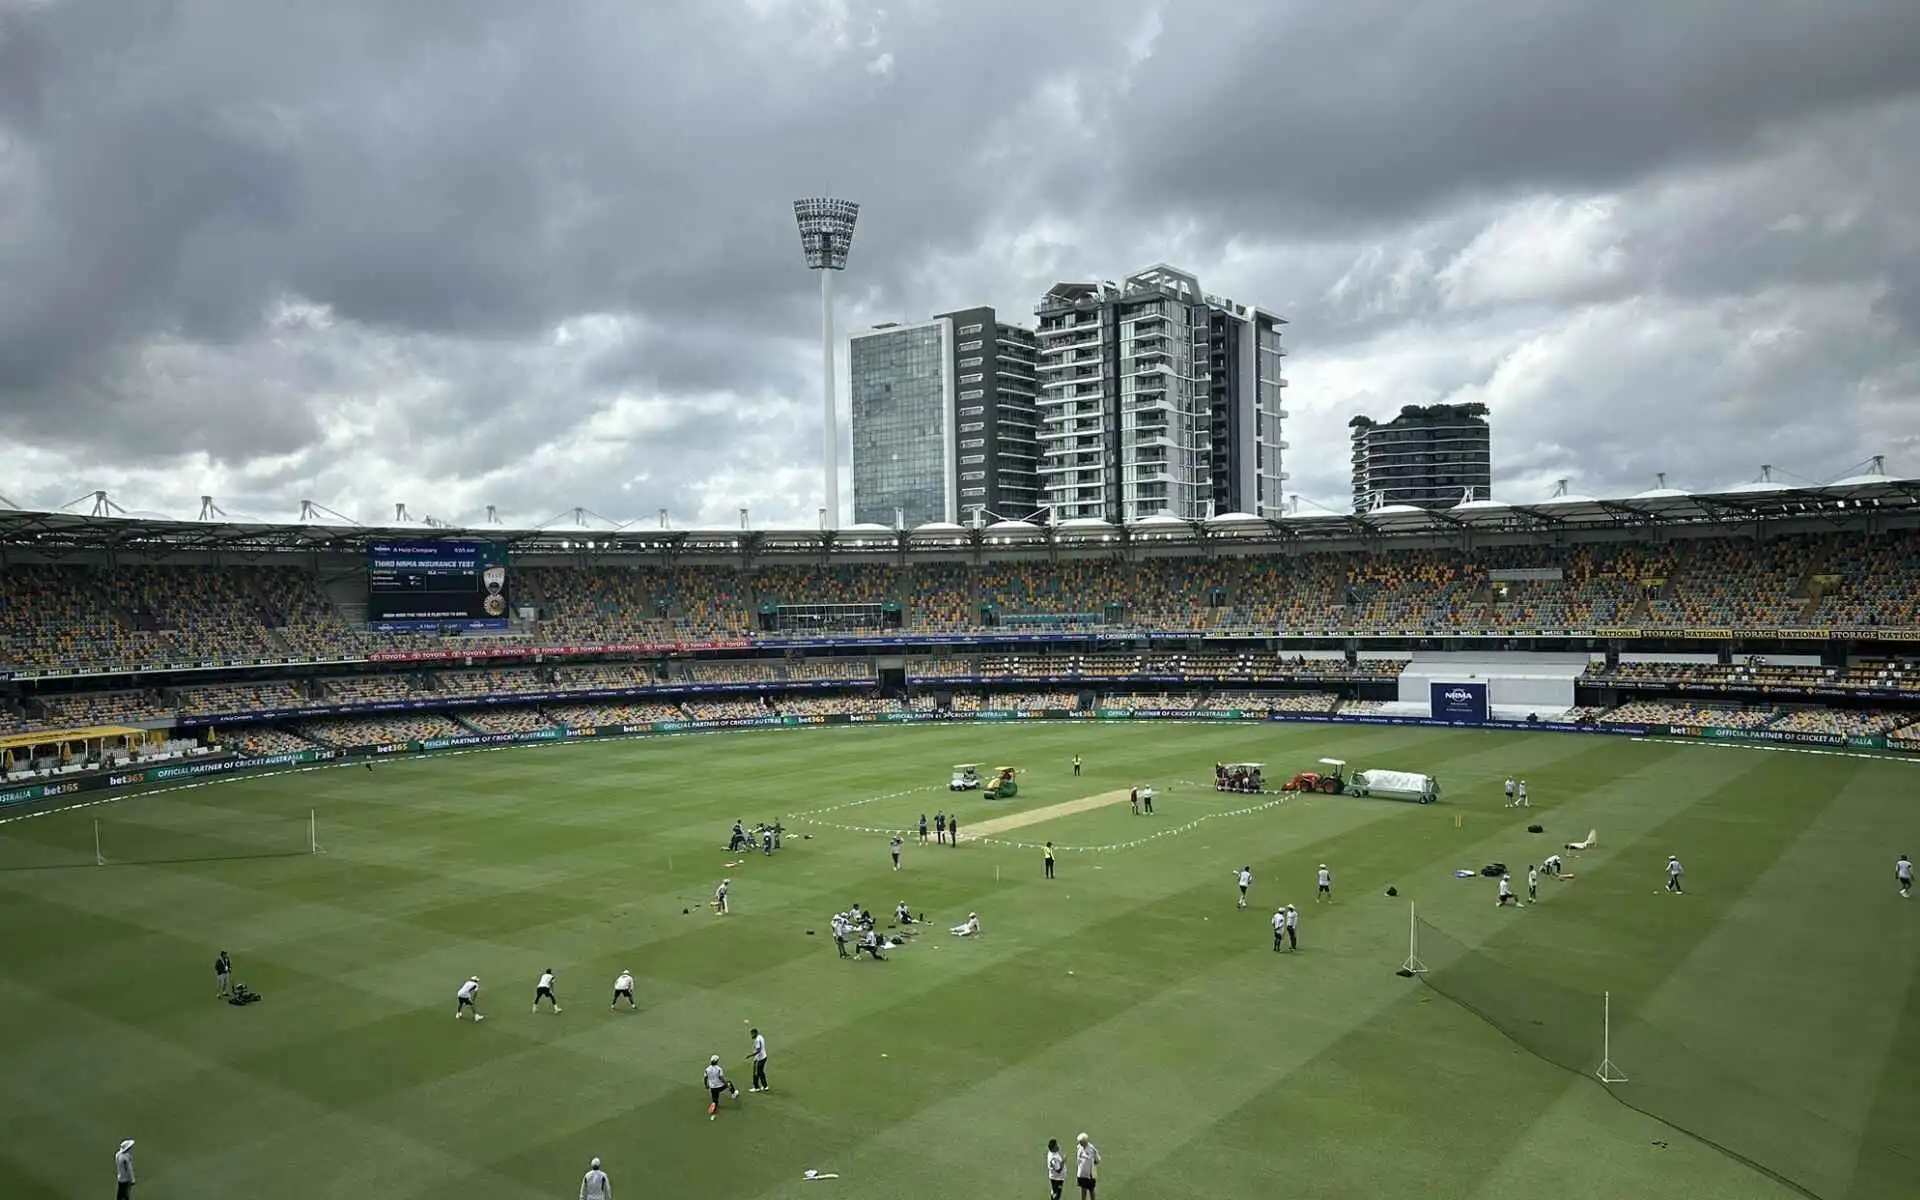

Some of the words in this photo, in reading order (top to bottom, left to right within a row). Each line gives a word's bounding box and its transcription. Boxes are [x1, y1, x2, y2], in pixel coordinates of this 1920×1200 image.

[1597, 630, 1640, 638] NATIONAL
[1686, 630, 1731, 638] NATIONAL
[1733, 631, 1777, 639] STORAGE
[1779, 631, 1827, 639] NATIONAL
[1831, 631, 1877, 639] STORAGE
[1445, 691, 1472, 700] NRMA
[730, 717, 755, 725] CRICKET
[1716, 729, 1748, 737] OFFICIAL
[1750, 731, 1783, 739] PARTNER
[1797, 733, 1828, 742] CRICKET
[451, 736, 480, 745] PARTNER
[158, 767, 189, 777] OFFICIAL
[190, 763, 222, 774] PARTNER
[235, 758, 264, 767] CRICKET
[110, 773, 145, 785] bet365
[44, 783, 78, 796] bet365
[0, 790, 31, 803] STRALIA
